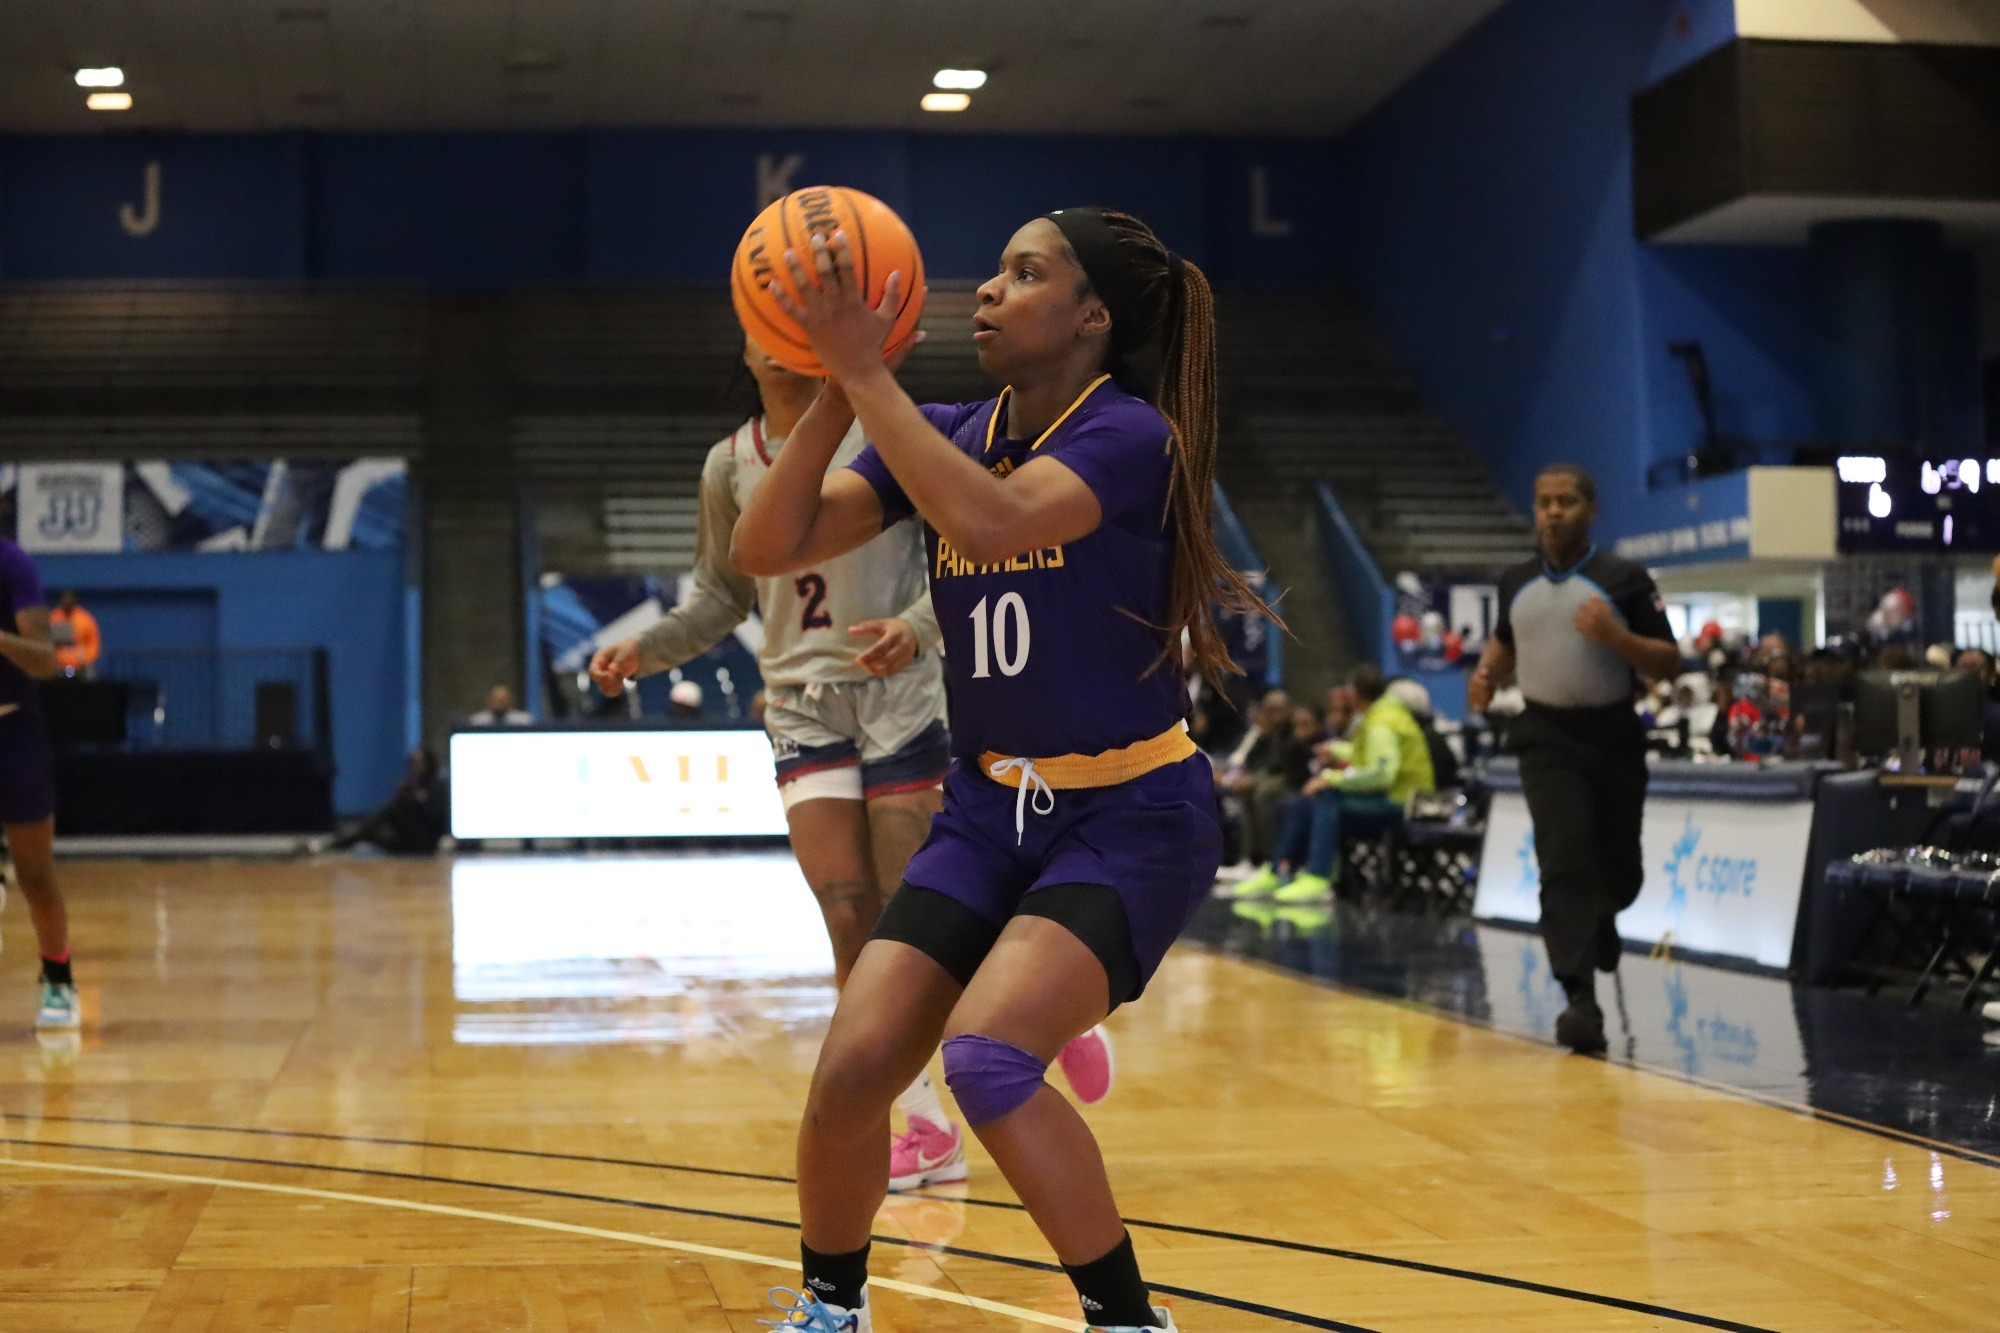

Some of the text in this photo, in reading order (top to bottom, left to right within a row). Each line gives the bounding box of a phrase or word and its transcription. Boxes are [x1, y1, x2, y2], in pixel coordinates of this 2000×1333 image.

[119, 163, 160, 236] J
[757, 154, 803, 213] K
[1251, 167, 1294, 235] L
[795, 571, 832, 632] 2
[968, 591, 1031, 679] 10
